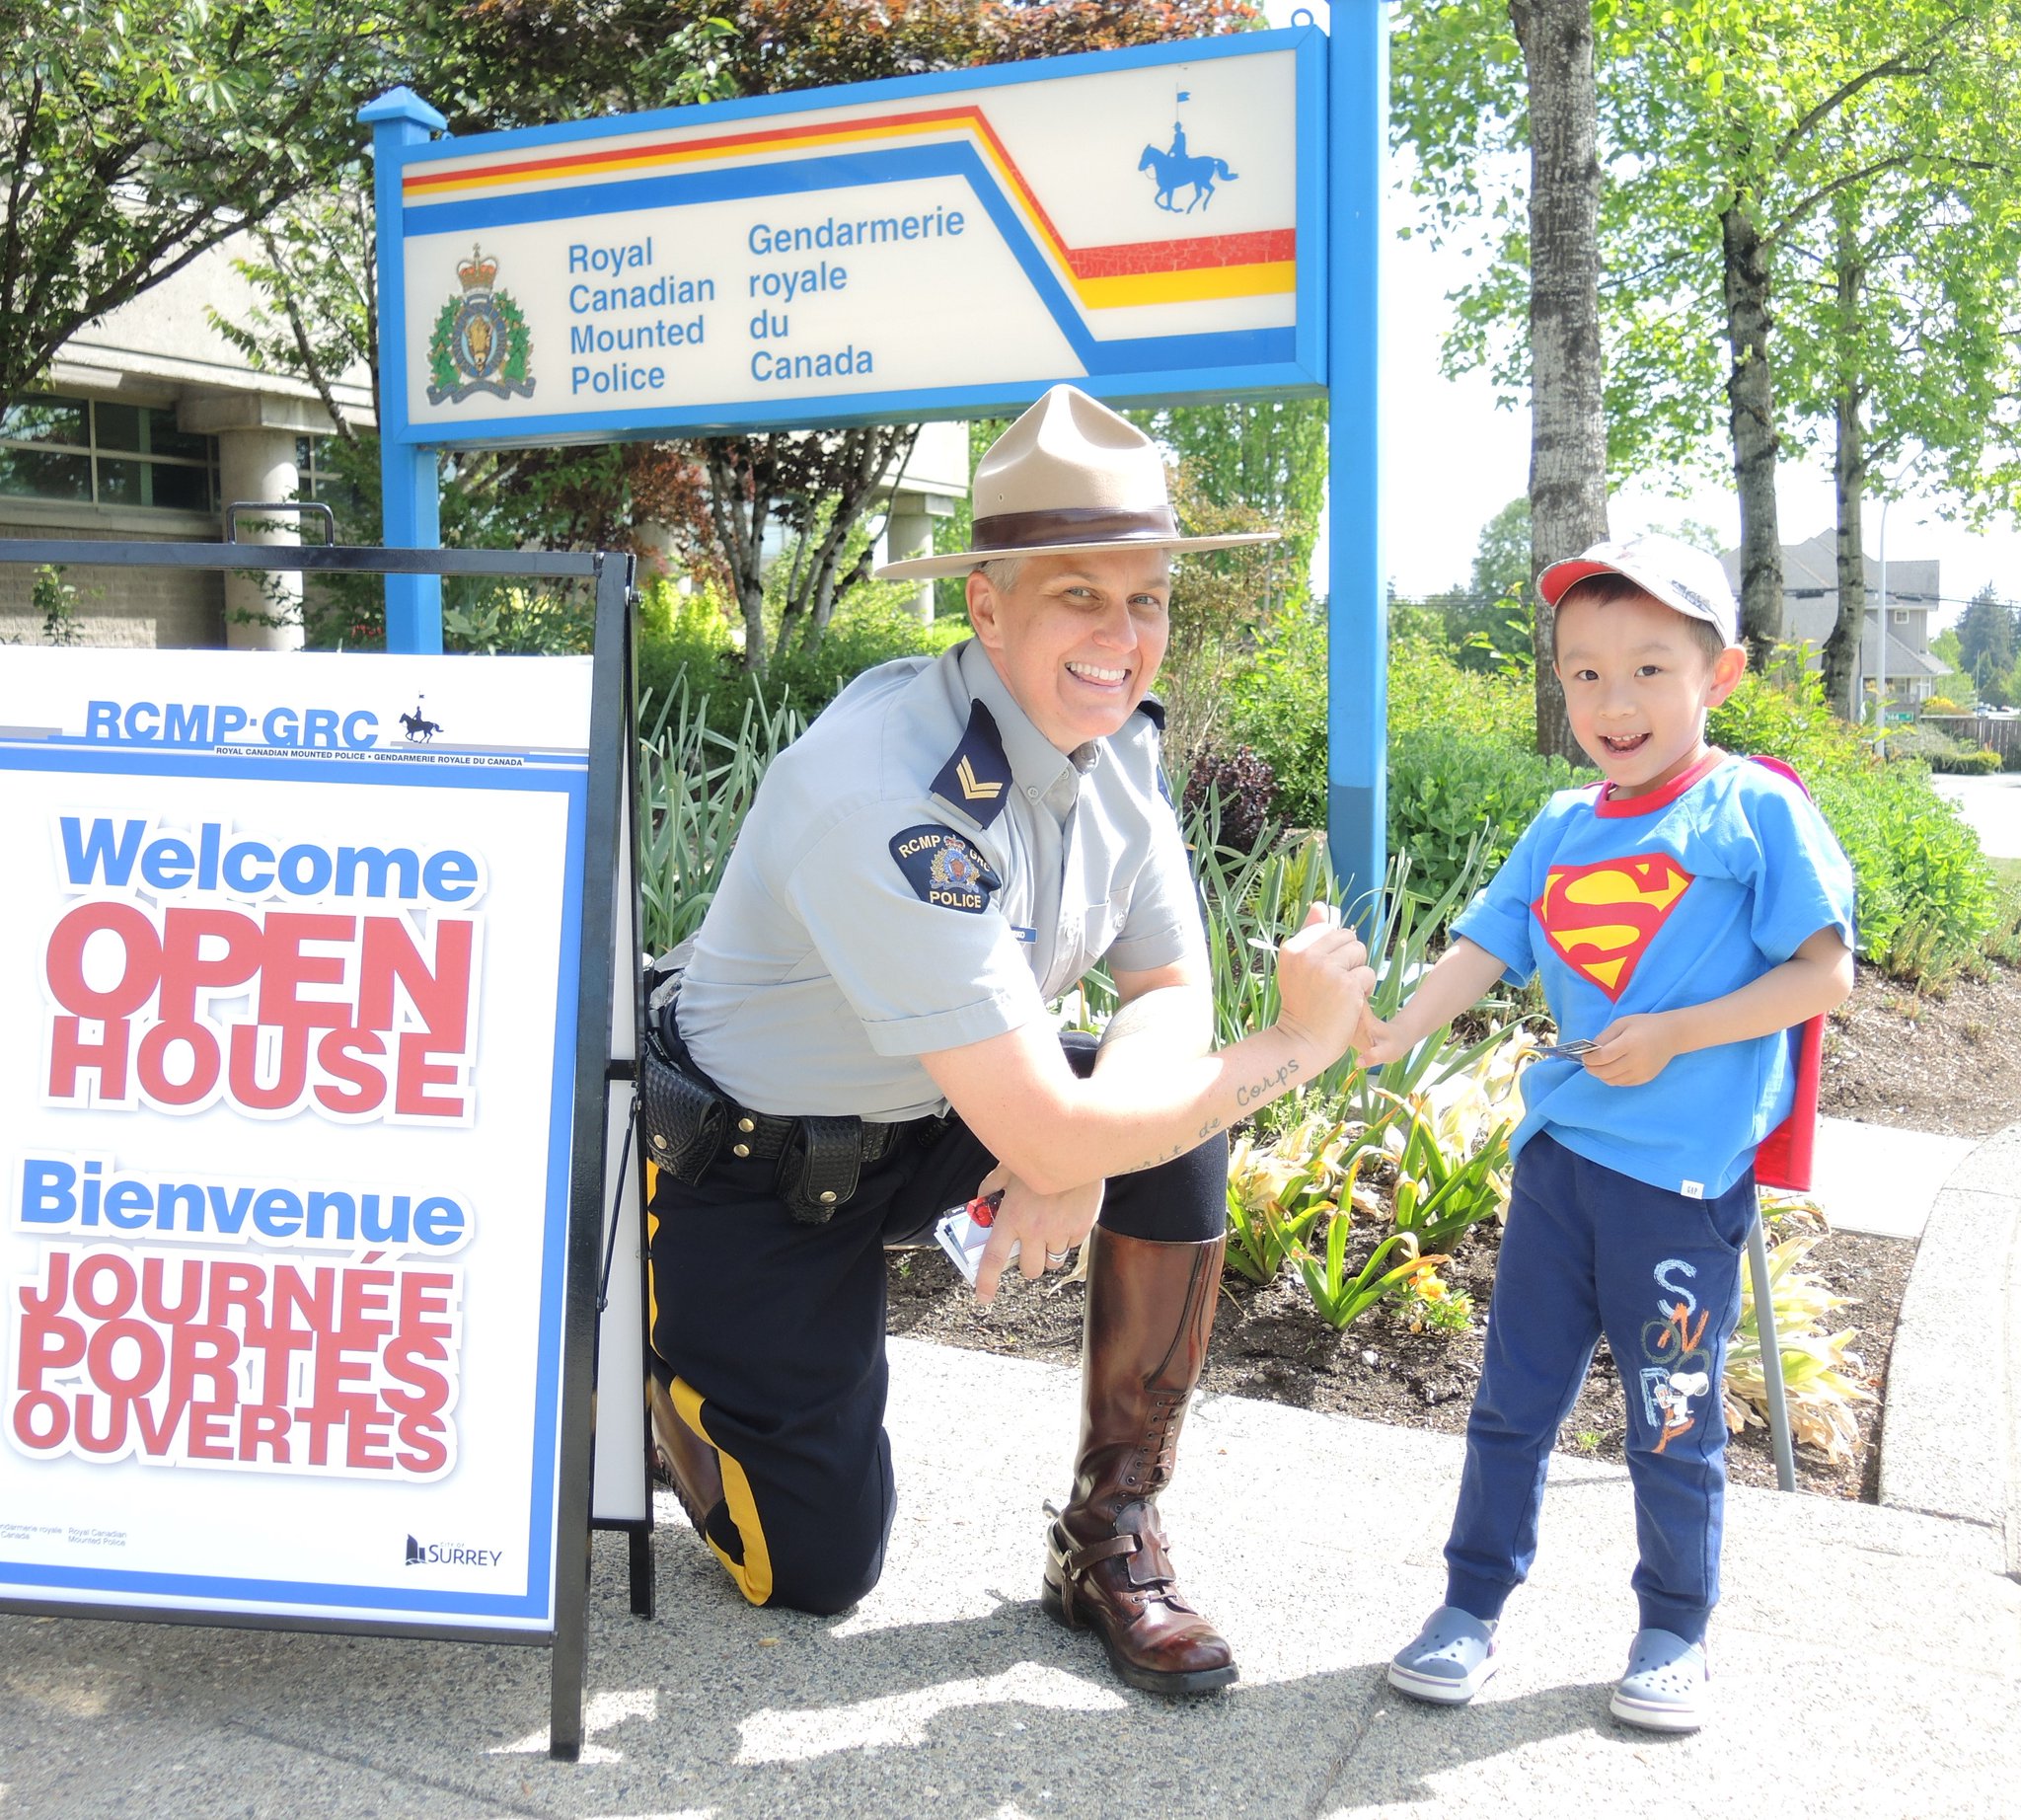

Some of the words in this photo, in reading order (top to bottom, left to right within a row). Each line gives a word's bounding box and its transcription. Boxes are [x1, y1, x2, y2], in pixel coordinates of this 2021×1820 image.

[748, 205, 965, 255] Gendarmerie
[568, 237, 653, 277] Royal
[568, 274, 715, 314] Canadian
[749, 261, 848, 303] royale
[570, 315, 705, 354] Mounted
[750, 309, 789, 340] du
[571, 362, 665, 395] Police
[750, 344, 874, 382] Canada
[215, 747, 244, 756] ROYAL
[245, 748, 288, 758] CANADIAN
[290, 749, 333, 759] MOUNTED
[335, 751, 366, 760] POLICE
[373, 753, 436, 763] GENDARMERIE
[437, 755, 471, 764] ROYALE
[487, 758, 523, 767] CANADA
[59, 815, 479, 902] Welcome
[898, 834, 941, 859] RCMP
[929, 890, 982, 909] POLICE
[45, 901, 474, 1054] OPEN
[48, 1015, 465, 1117] HOUSE
[1198, 1116, 1222, 1139] de
[1235, 1058, 1300, 1107] Corps
[21, 1158, 465, 1247] Bienvenue
[19, 1251, 454, 1339] JOURNÉE
[17, 1313, 451, 1417] PORTES
[13, 1390, 448, 1474] OUVERTES
[68, 1527, 90, 1537] Royal
[91, 1528, 127, 1539] Canadian
[68, 1536, 102, 1546] Mounted
[103, 1537, 126, 1547] Police
[428, 1544, 503, 1567] SURREY
